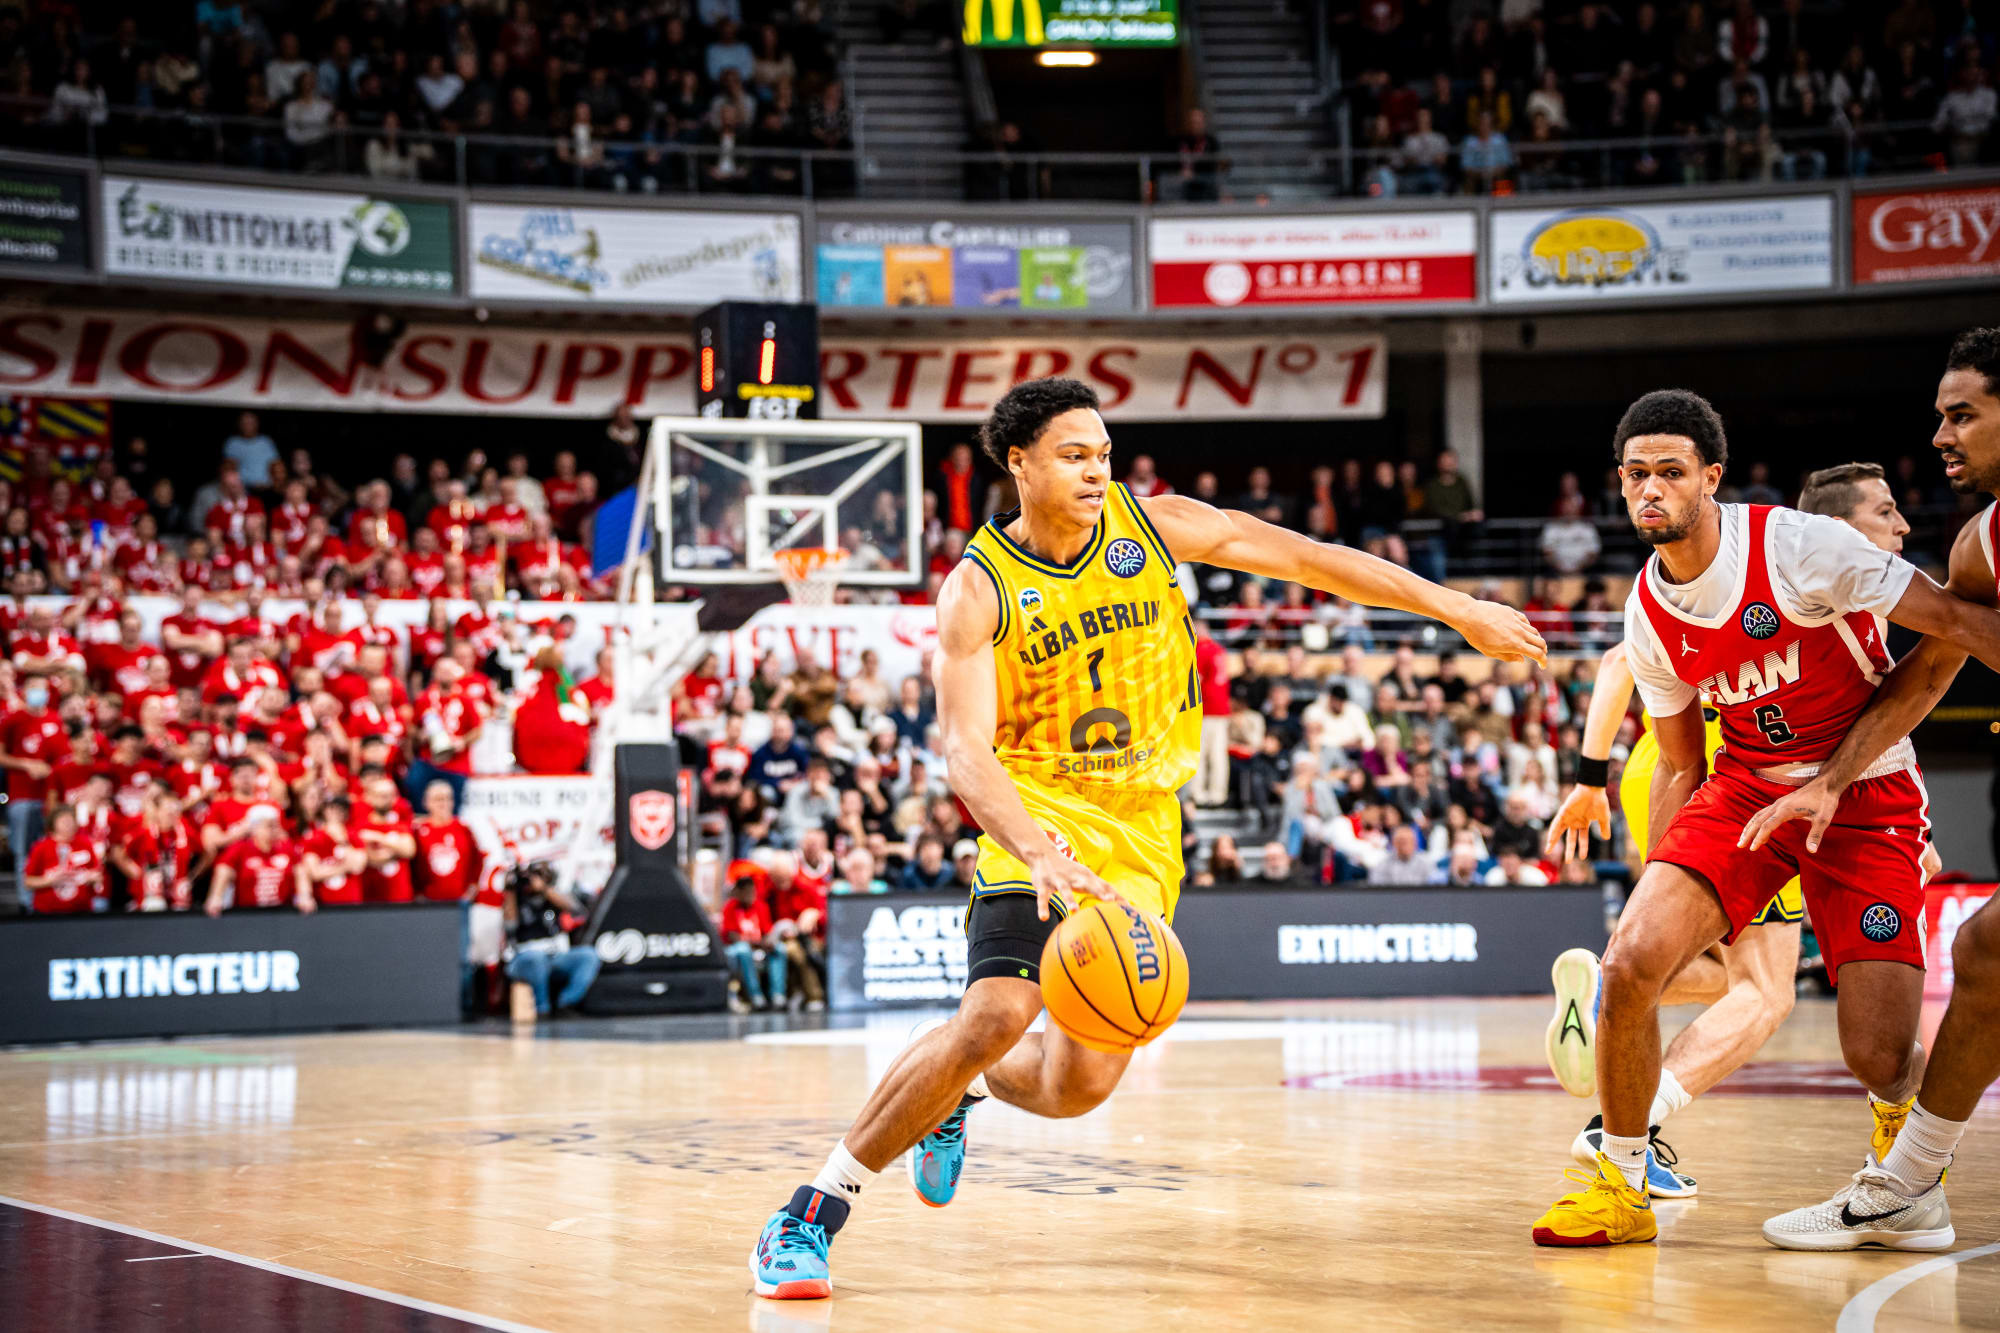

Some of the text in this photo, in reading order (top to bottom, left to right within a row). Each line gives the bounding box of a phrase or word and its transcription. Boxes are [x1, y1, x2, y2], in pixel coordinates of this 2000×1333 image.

[394, 334, 1138, 410] SUPPRTERS
[1018, 600, 1160, 667] ALBA BERLIN
[1057, 747, 1154, 775] Schindler
[1277, 922, 1478, 964] EXTINCTEUR
[48, 949, 300, 1001] EXTINCTEUR
